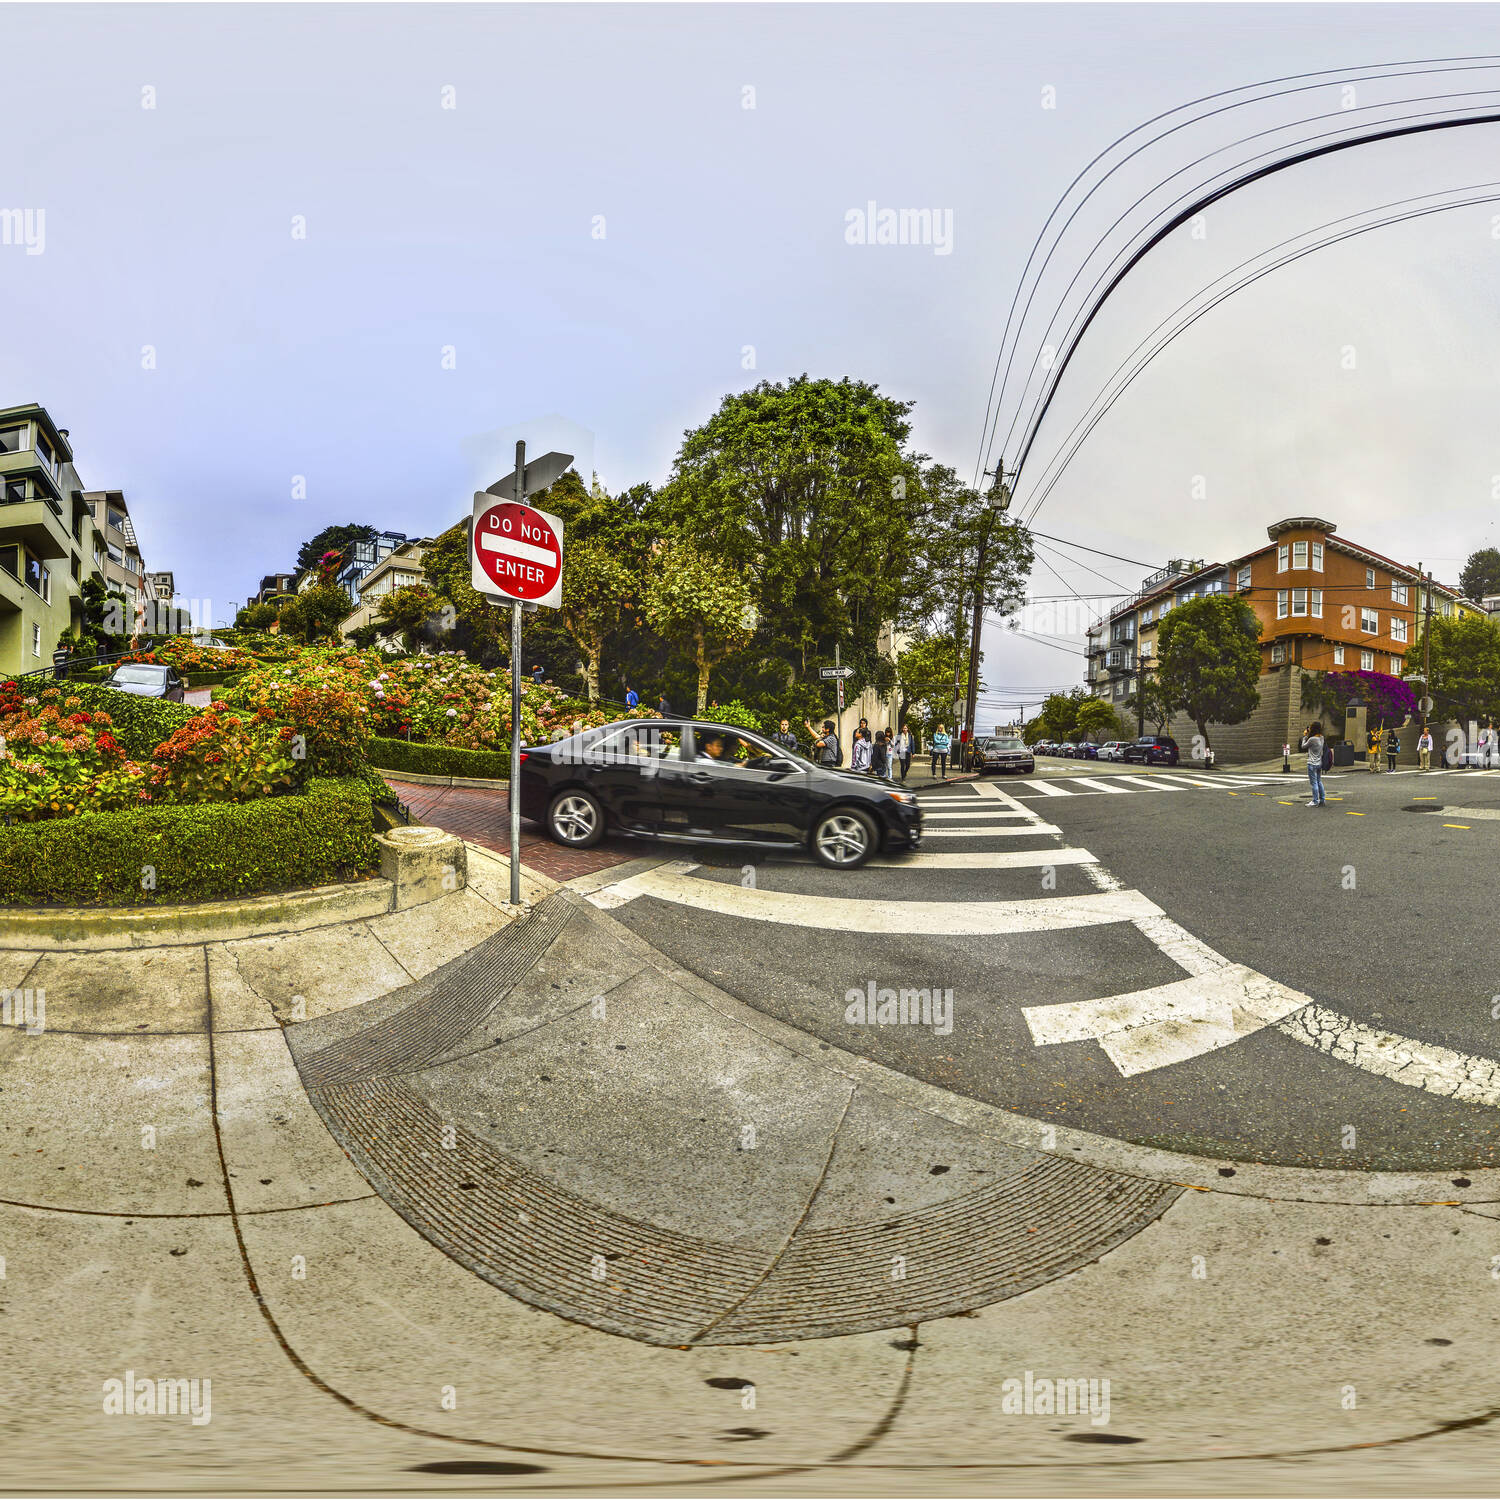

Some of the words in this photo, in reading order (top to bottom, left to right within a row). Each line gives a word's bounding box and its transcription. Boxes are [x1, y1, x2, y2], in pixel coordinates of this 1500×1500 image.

[490, 514, 512, 533] DO
[521, 522, 551, 544] NOT
[496, 558, 545, 585] ENTER
